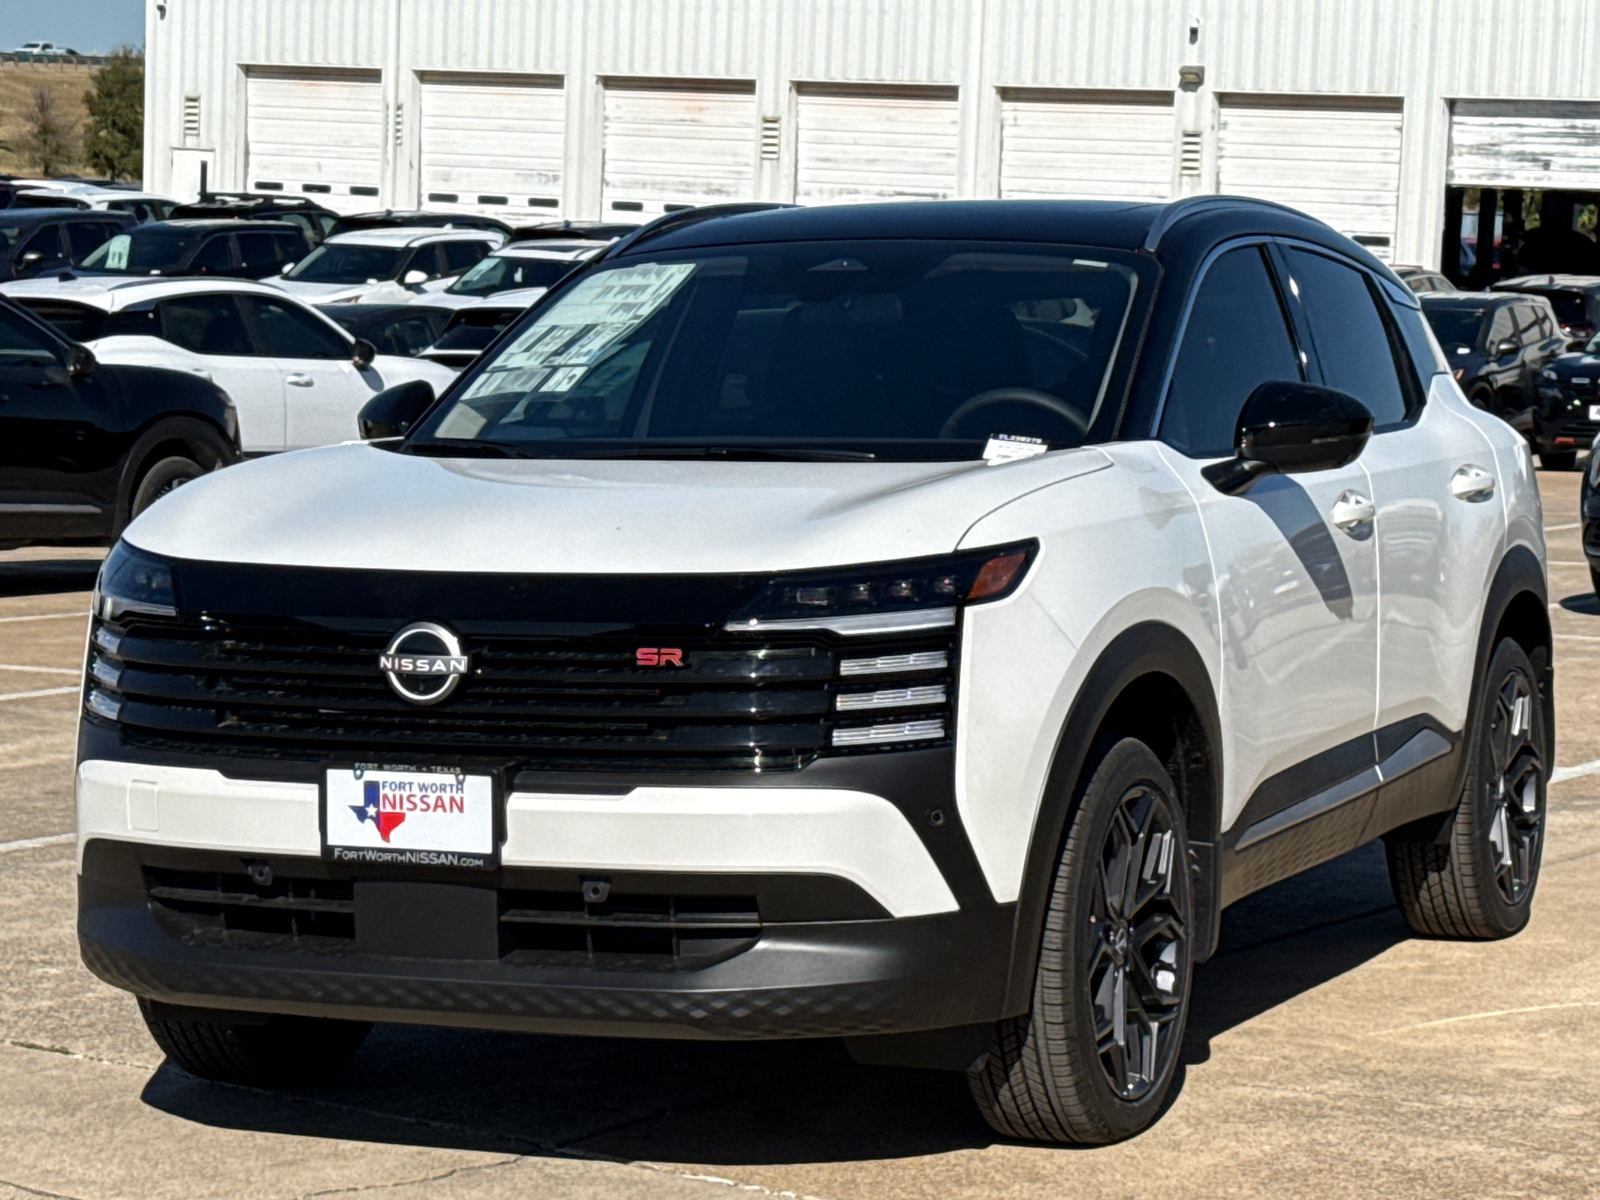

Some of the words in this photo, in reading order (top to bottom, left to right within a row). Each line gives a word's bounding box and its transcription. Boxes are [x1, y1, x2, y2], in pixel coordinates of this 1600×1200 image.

[379, 655, 466, 673] NISSAN
[636, 648, 683, 667] SR
[431, 766, 461, 775] TEXAS
[382, 781, 415, 792] FORT
[418, 782, 464, 794] WORTH
[382, 793, 464, 814] NISSAN
